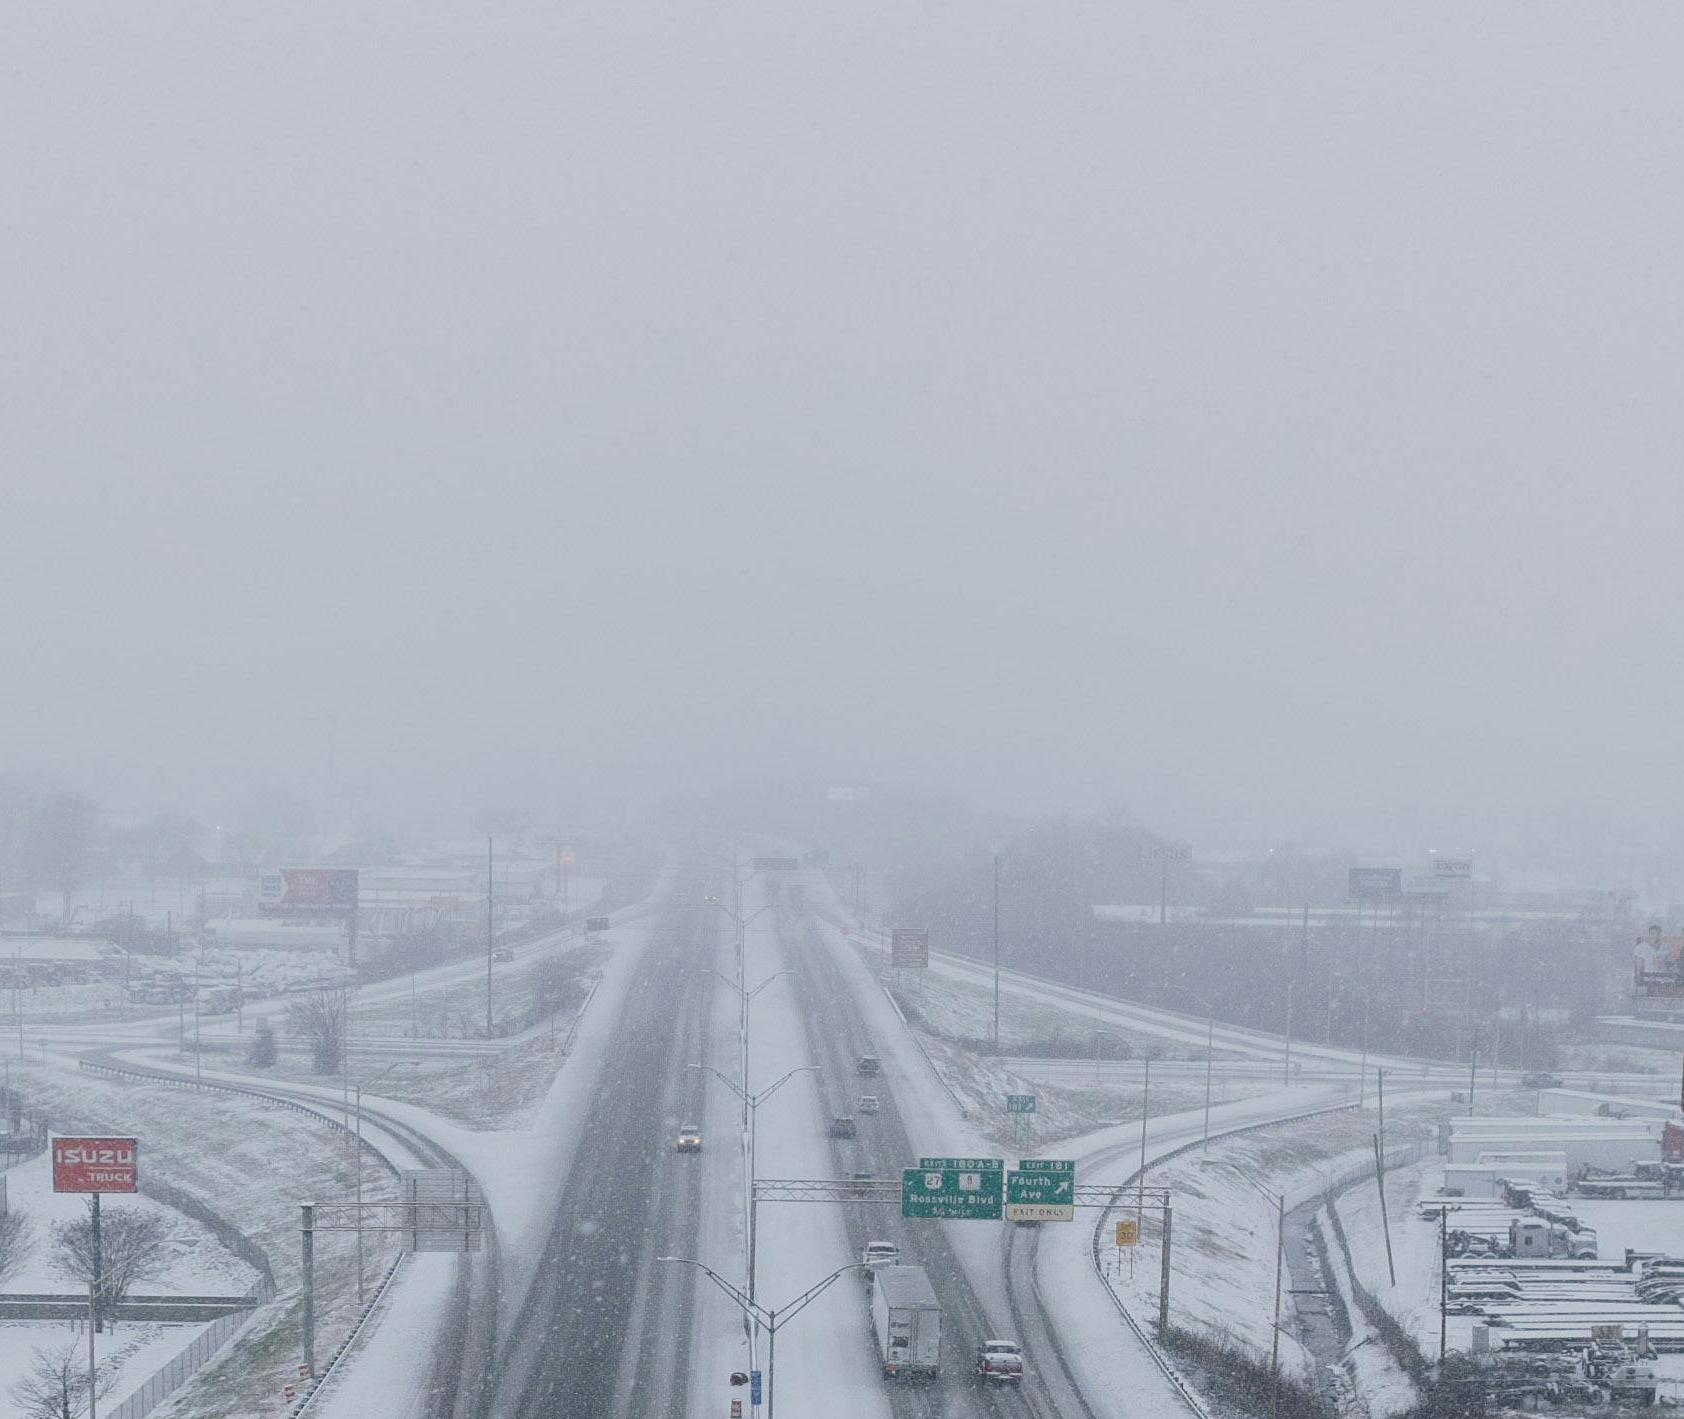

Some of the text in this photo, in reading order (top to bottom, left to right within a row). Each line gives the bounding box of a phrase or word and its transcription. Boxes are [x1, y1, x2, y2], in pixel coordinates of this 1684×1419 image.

[56, 1148, 132, 1165] ISUZU
[87, 1172, 132, 1182] TRUCK
[926, 1175, 941, 1185] 27
[1012, 1176, 1051, 1186] Fourth
[910, 1194, 994, 1205] Rossville Blvd
[1020, 1190, 1042, 1199] Ave
[1013, 1208, 1034, 1216] EXIT
[1120, 1232, 1133, 1240] 30
